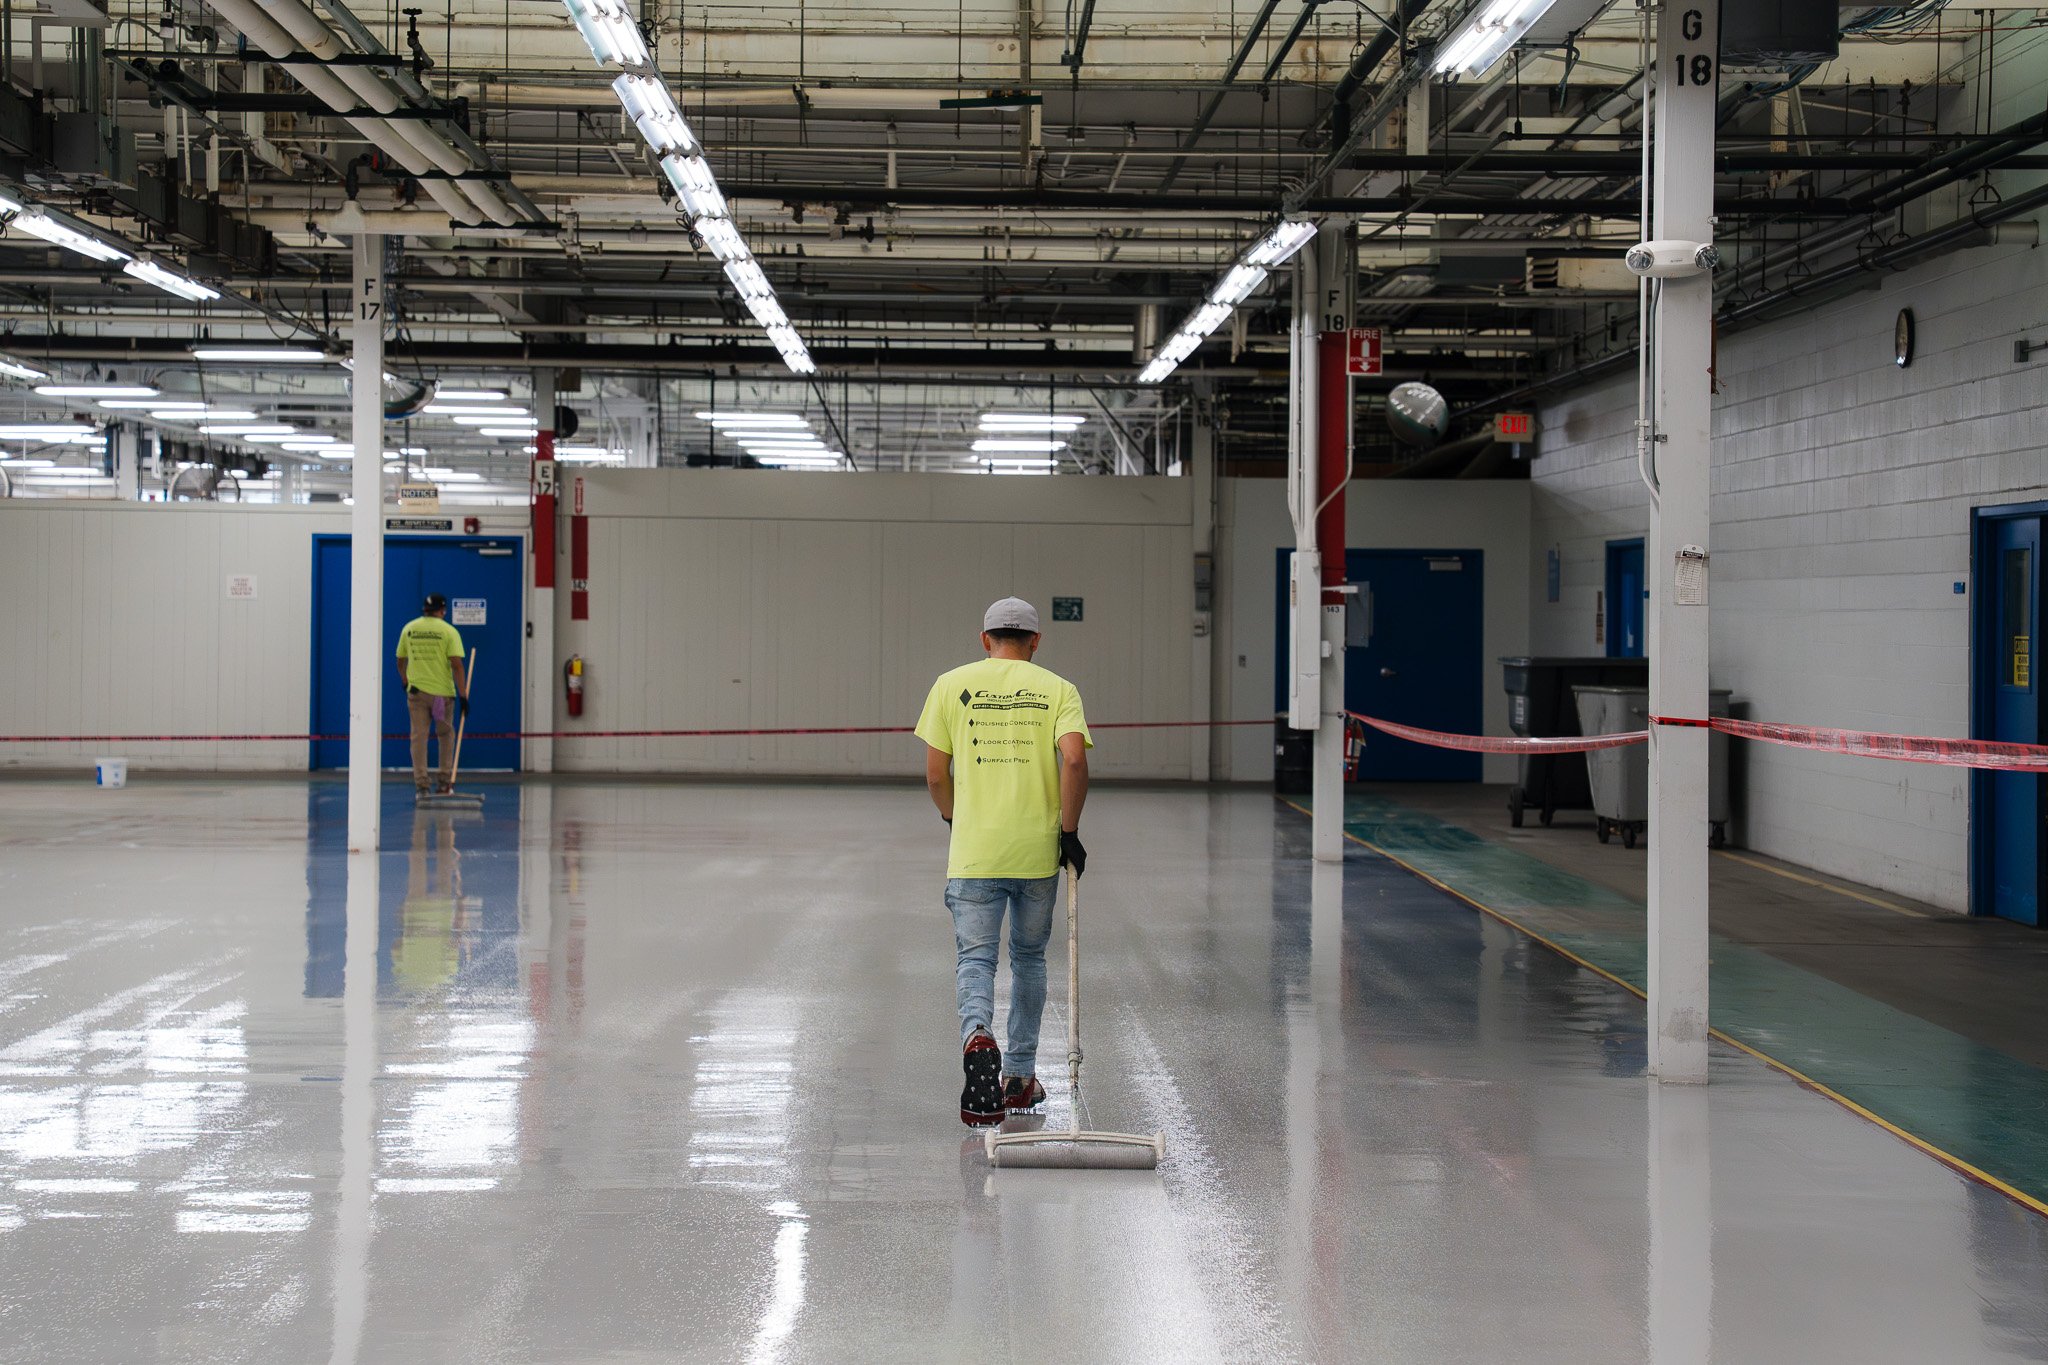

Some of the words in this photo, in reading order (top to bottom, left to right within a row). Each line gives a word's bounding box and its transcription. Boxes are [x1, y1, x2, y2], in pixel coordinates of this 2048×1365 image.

[1683, 9, 1702, 41] G
[1675, 54, 1712, 87] 18
[365, 279, 376, 296] F
[1328, 290, 1340, 308] F
[360, 302, 380, 320] 17
[1325, 314, 1344, 331] 18
[1352, 329, 1379, 339] FIRE
[1502, 415, 1528, 434] EXIT
[541, 466, 550, 479] E
[402, 489, 436, 498] NOTICE
[538, 482, 551, 495] 17
